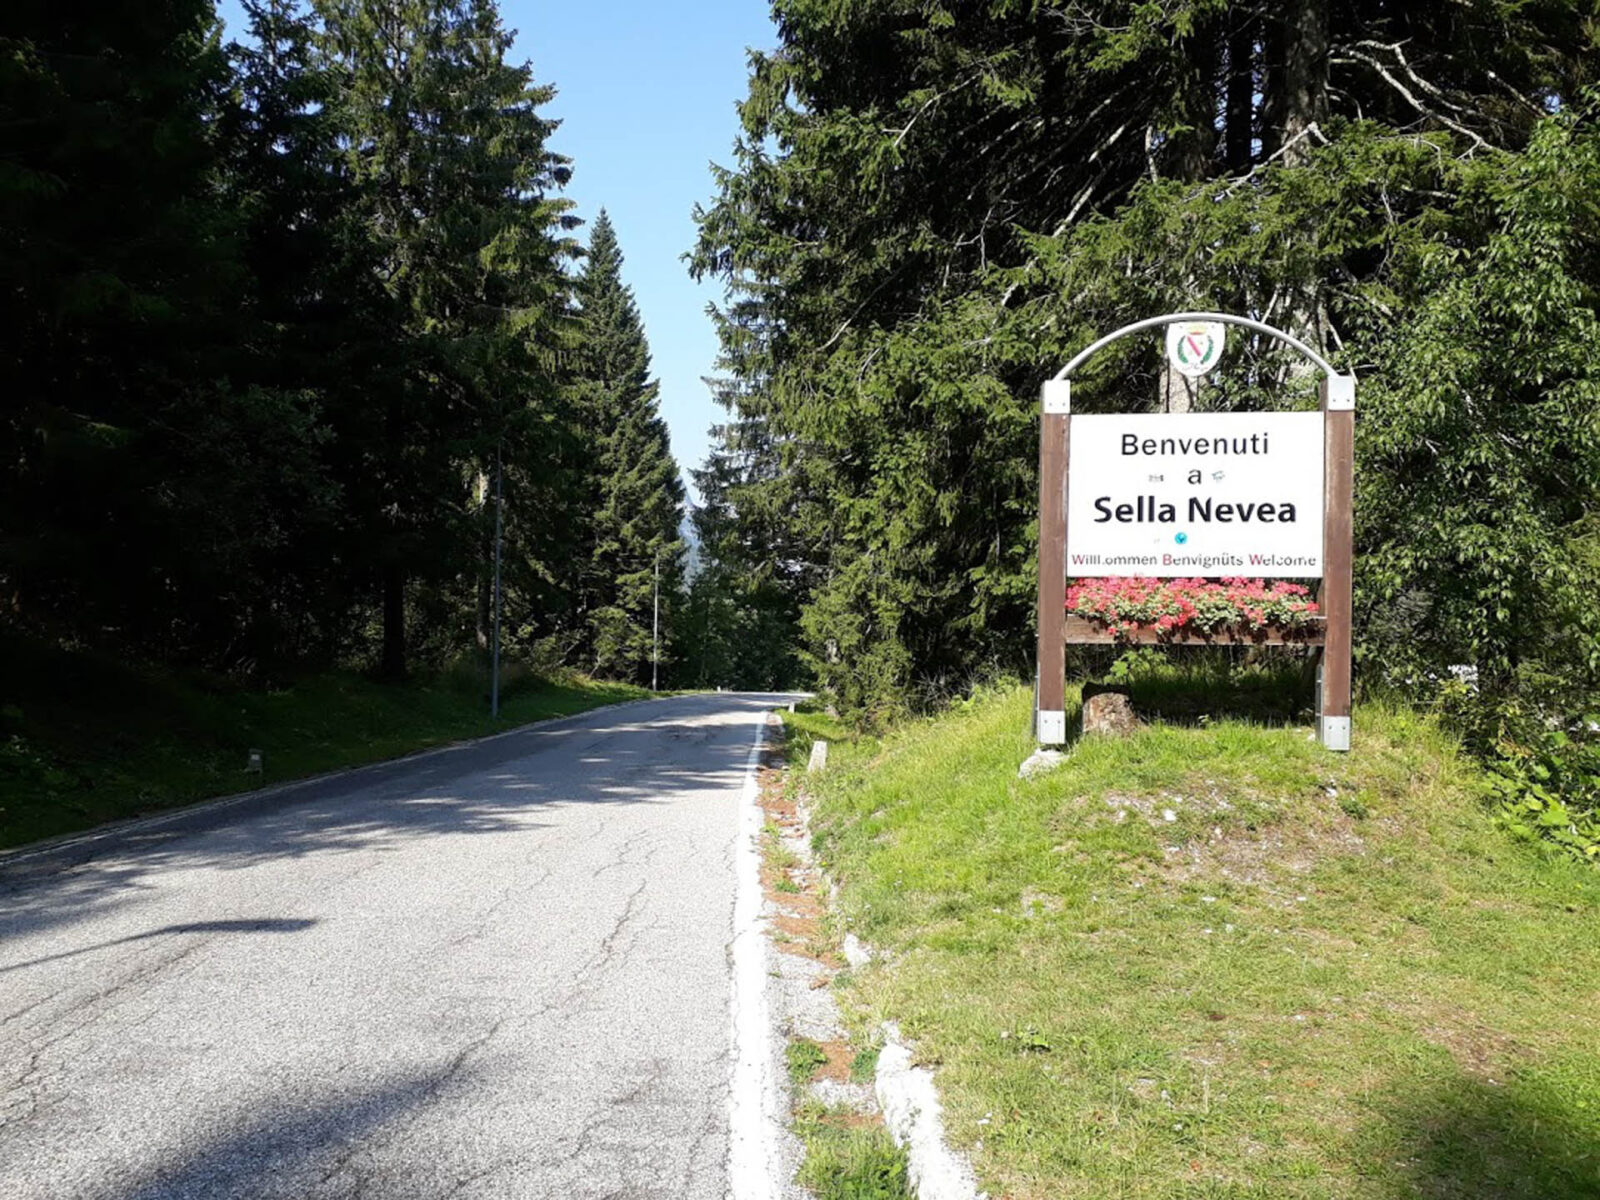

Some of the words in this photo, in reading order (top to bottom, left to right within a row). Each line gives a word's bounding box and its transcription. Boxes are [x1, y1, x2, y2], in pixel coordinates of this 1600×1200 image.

[1122, 432, 1268, 455] Benvenuti
[1188, 470, 1201, 484] a
[1094, 495, 1175, 523] Sella
[1189, 497, 1296, 523] Nevea
[1163, 553, 1243, 568] Benvignüts
[1249, 555, 1316, 566] Welcome
